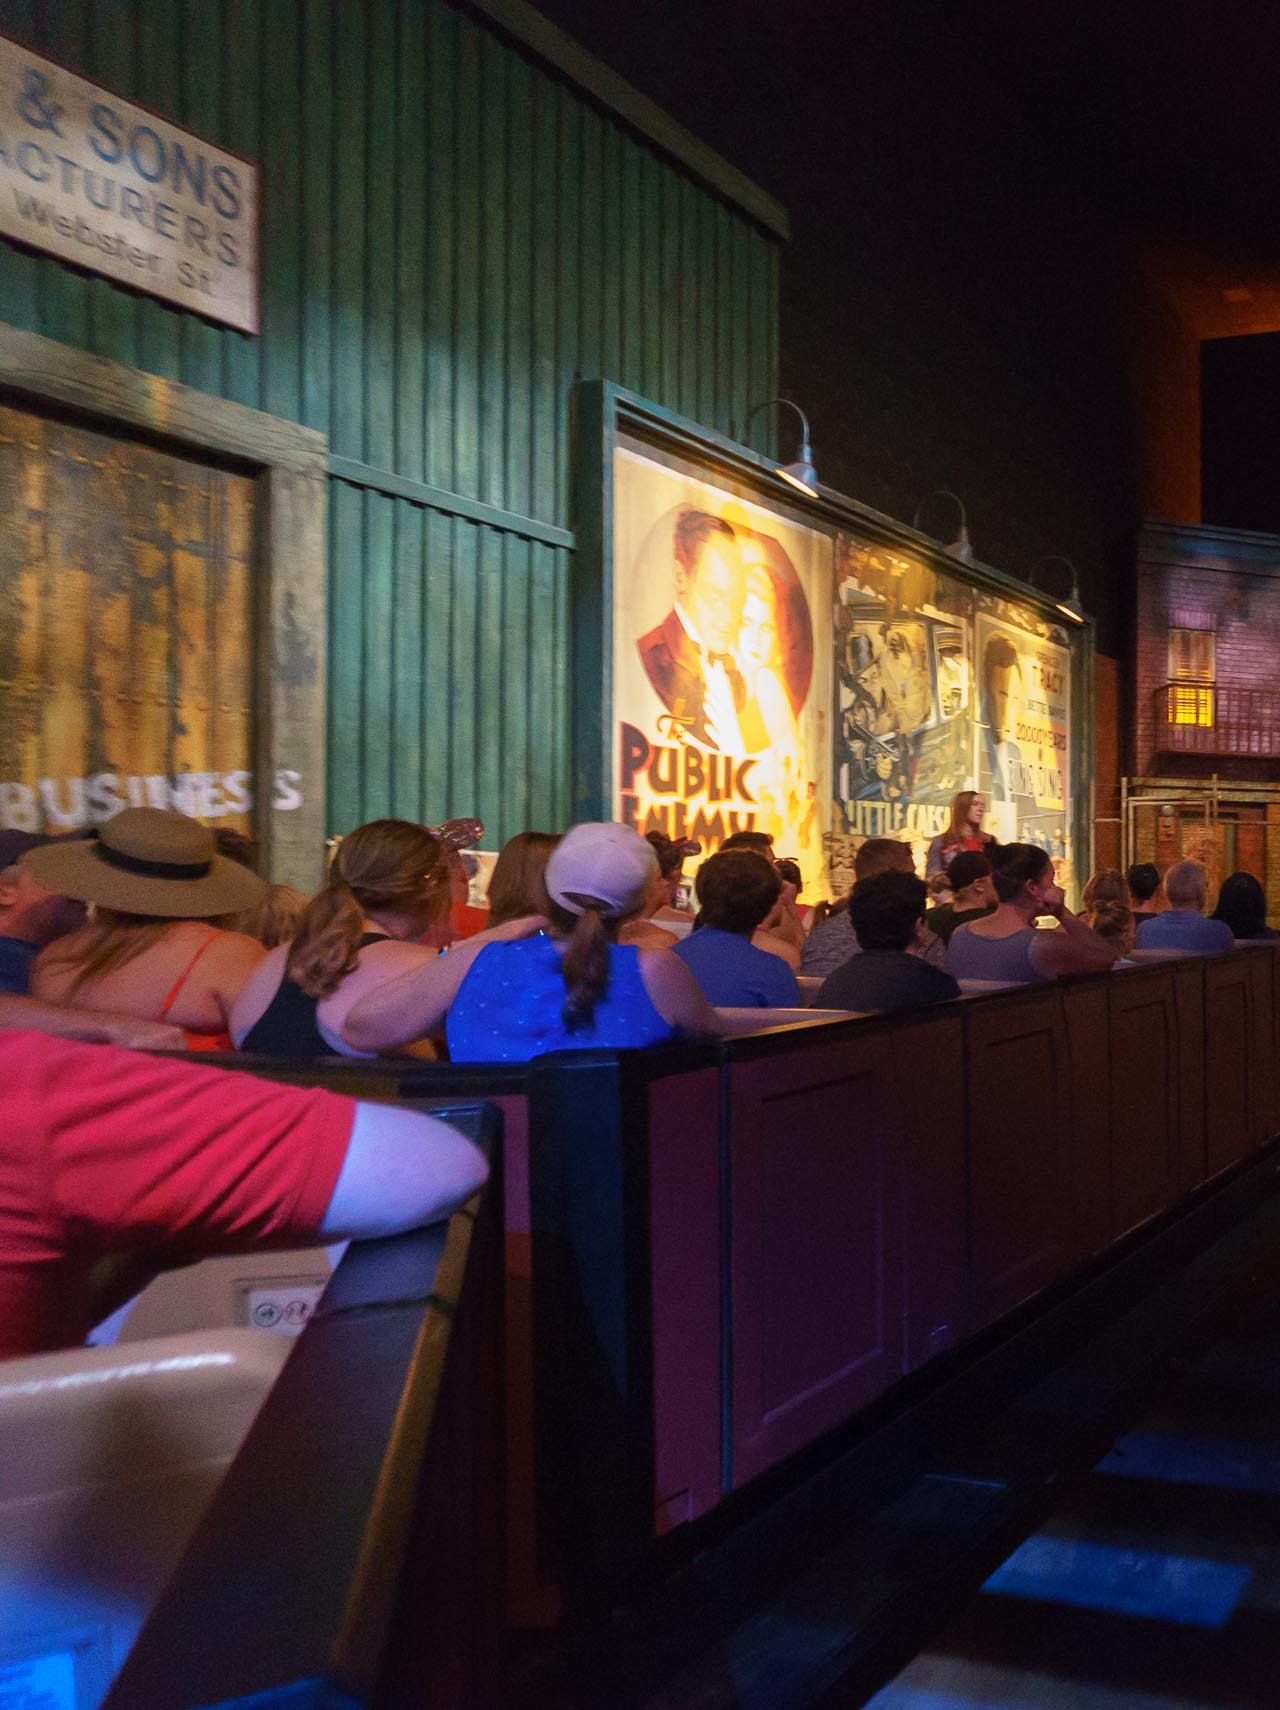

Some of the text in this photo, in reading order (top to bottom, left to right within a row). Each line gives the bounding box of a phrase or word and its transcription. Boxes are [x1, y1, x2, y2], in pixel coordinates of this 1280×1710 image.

[17, 68, 241, 220] & SONS
[13, 188, 160, 272] Webster
[620, 719, 760, 804] PUBLIC
[847, 799, 906, 838] LITTLE
